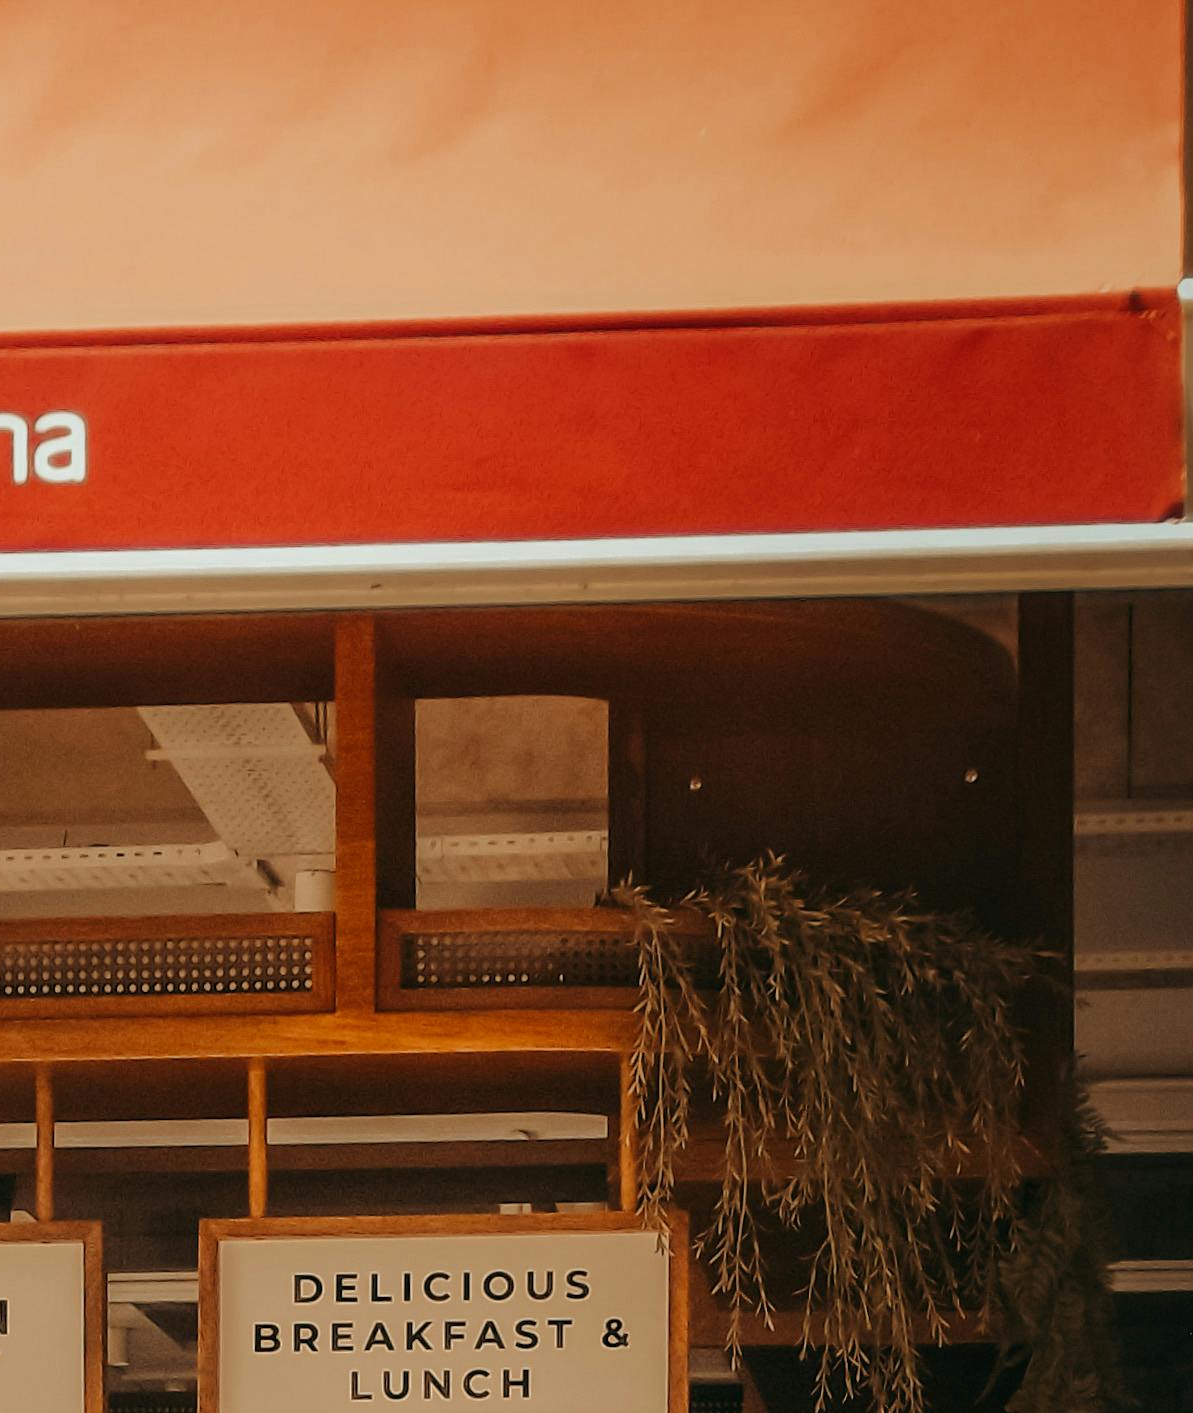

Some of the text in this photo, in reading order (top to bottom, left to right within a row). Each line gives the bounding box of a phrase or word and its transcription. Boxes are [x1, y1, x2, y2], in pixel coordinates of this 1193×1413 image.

[294, 1270, 591, 1304] DELICIOUS
[254, 1318, 630, 1353] BREAKFAST &
[351, 1369, 531, 1401] LUNCH
